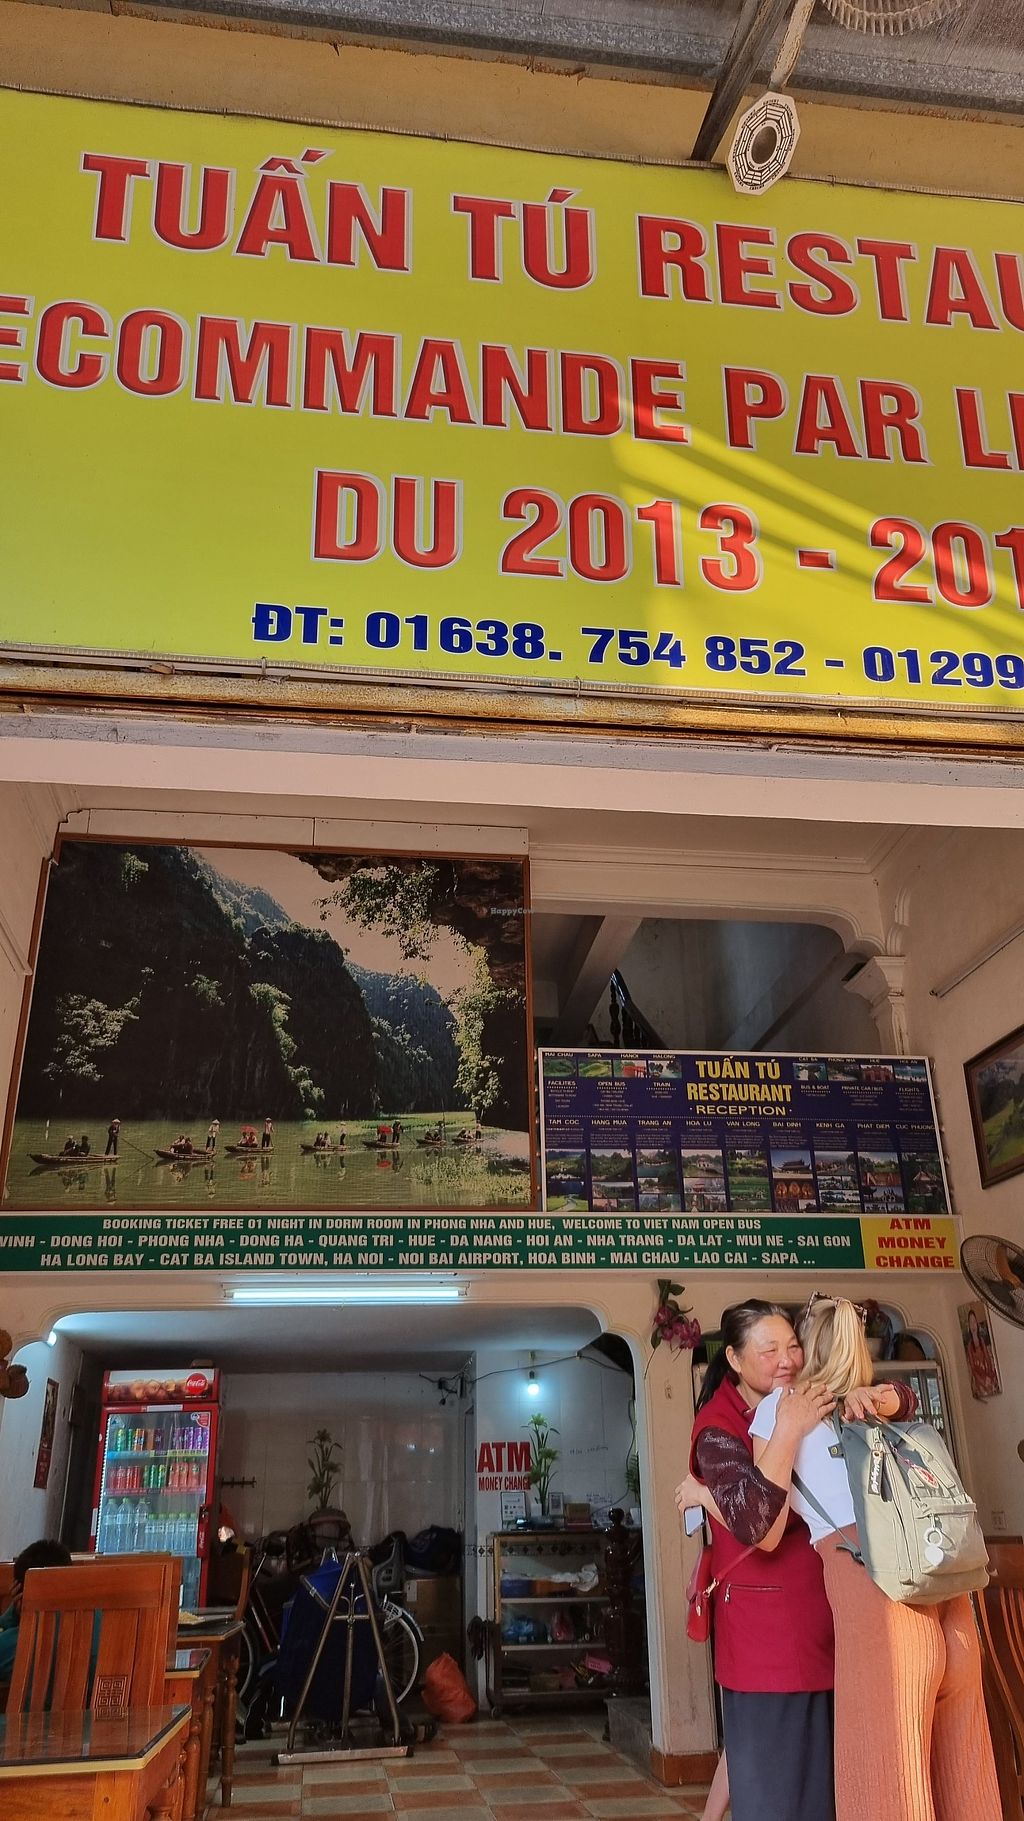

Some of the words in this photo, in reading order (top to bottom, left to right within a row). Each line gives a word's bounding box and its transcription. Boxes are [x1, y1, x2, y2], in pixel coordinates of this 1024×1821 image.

[82, 149, 414, 274] TUẤN
[452, 189, 596, 291] TÚ
[724, 365, 932, 466] PAR
[955, 386, 1024, 472] L
[311, 467, 464, 569] DU
[499, 486, 763, 593] 2013
[798, 546, 836, 572] -
[869, 514, 1024, 611] 201
[252, 604, 345, 647] ĐT:
[364, 611, 563, 662] 01638.
[581, 626, 687, 669] 754
[705, 634, 806, 677] 852
[824, 659, 843, 668] -
[862, 645, 1024, 690] 01299
[695, 1055, 750, 1079] TUẤN
[755, 1058, 781, 1080] TÚ
[686, 1083, 792, 1102] RESTAURANT
[696, 1105, 786, 1116] RECEPTION
[103, 1219, 162, 1229] BOOKING
[165, 1219, 210, 1229] TICKET
[213, 1219, 244, 1229] FREE
[248, 1219, 262, 1229] 01
[267, 1219, 306, 1229] NIGHT
[309, 1219, 322, 1229] IN
[326, 1219, 363, 1229] DORM
[367, 1219, 404, 1229] ROOM
[407, 1219, 421, 1229] IN
[424, 1219, 468, 1229] PHONG
[470, 1219, 496, 1229] NHA
[499, 1219, 525, 1229] AND
[528, 1219, 555, 1230] HUE,
[562, 1219, 622, 1229] WELCOME
[625, 1219, 640, 1229] TO
[644, 1219, 670, 1229] VIET
[672, 1219, 700, 1229] NAM
[703, 1219, 734, 1229] OPEN
[738, 1219, 761, 1229] BUS
[890, 1218, 931, 1230] ATM
[0, 1236, 36, 1247] VINH
[50, 1236, 92, 1247] DONG
[97, 1235, 123, 1247] HOI
[138, 1235, 190, 1247] PHONG
[194, 1235, 225, 1247] NHA
[239, 1235, 280, 1247] DONG
[284, 1235, 304, 1246] HA
[318, 1235, 368, 1246] QUANG
[372, 1235, 394, 1246] TRI
[408, 1235, 436, 1246] HUE
[450, 1235, 470, 1246] DA
[473, 1235, 513, 1246] NANG
[526, 1235, 549, 1246] HOI
[554, 1235, 573, 1246] AN
[587, 1235, 616, 1246] NHA
[619, 1235, 664, 1246] TRANG
[677, 1235, 696, 1246] DA
[700, 1235, 723, 1246] LAT
[736, 1235, 762, 1246] MUI
[766, 1235, 784, 1246] NE
[797, 1235, 820, 1246] SAI
[823, 1235, 851, 1246] GON
[878, 1237, 946, 1249] MONEY
[40, 1254, 62, 1266] HA
[67, 1254, 108, 1266] LONG
[113, 1254, 144, 1265] BAY
[160, 1254, 190, 1265] CAT
[194, 1253, 215, 1265] BA
[219, 1253, 275, 1265] ISLAND
[280, 1253, 328, 1266] TOWN,
[333, 1253, 352, 1265] HA
[358, 1253, 384, 1264] NOI
[399, 1253, 424, 1264] NOI
[429, 1253, 454, 1264] BAI
[458, 1253, 524, 1266] AIRPORT,
[528, 1253, 558, 1264] HOA
[562, 1253, 596, 1264] BINH
[610, 1253, 638, 1264] MAI
[642, 1253, 680, 1264] CHAU
[694, 1253, 720, 1264] LAO
[724, 1253, 748, 1264] CAI
[762, 1253, 799, 1264] SAPA
[876, 1255, 955, 1268] CHANGE
[478, 1441, 531, 1472] ATM
[479, 1476, 503, 1491] MONEY
